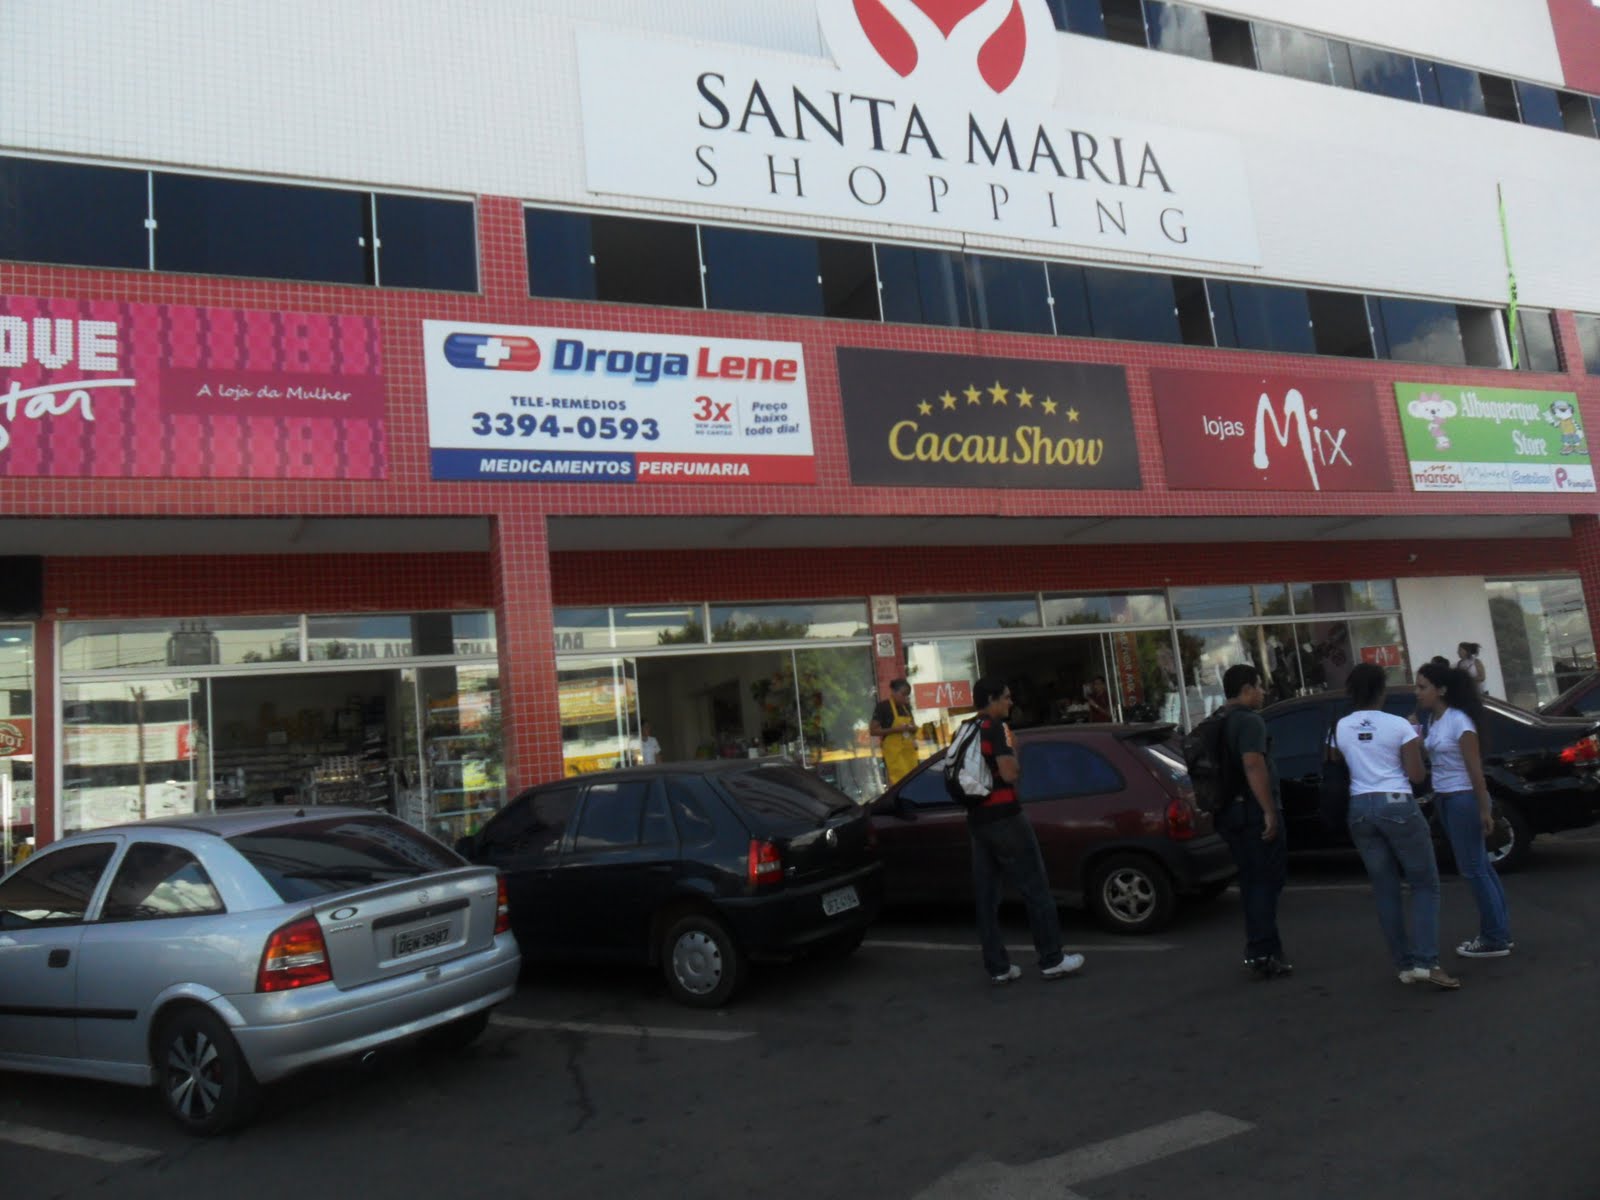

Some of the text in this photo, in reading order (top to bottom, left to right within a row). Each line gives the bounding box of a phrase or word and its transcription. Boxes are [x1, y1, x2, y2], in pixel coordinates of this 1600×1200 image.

[695, 71, 1175, 194] SANTA MARIA
[695, 145, 1189, 244] SHOPPING
[552, 338, 798, 383] Droga Lene
[196, 383, 352, 401] A loja da Mulher
[511, 395, 627, 411] TELE-REMÉDIOS
[693, 395, 732, 422] 3x
[751, 401, 788, 412] Preço
[754, 413, 788, 424] baixo
[1460, 391, 1541, 426] Albuquerque
[471, 412, 661, 441] 3394-0593
[745, 423, 800, 436] todo dia!
[1202, 388, 1353, 491] lojas Mix
[888, 420, 1104, 466] Cacau Show
[1512, 429, 1549, 456] Store
[480, 457, 750, 476] MEDICAMENTOS PERFUMARIA
